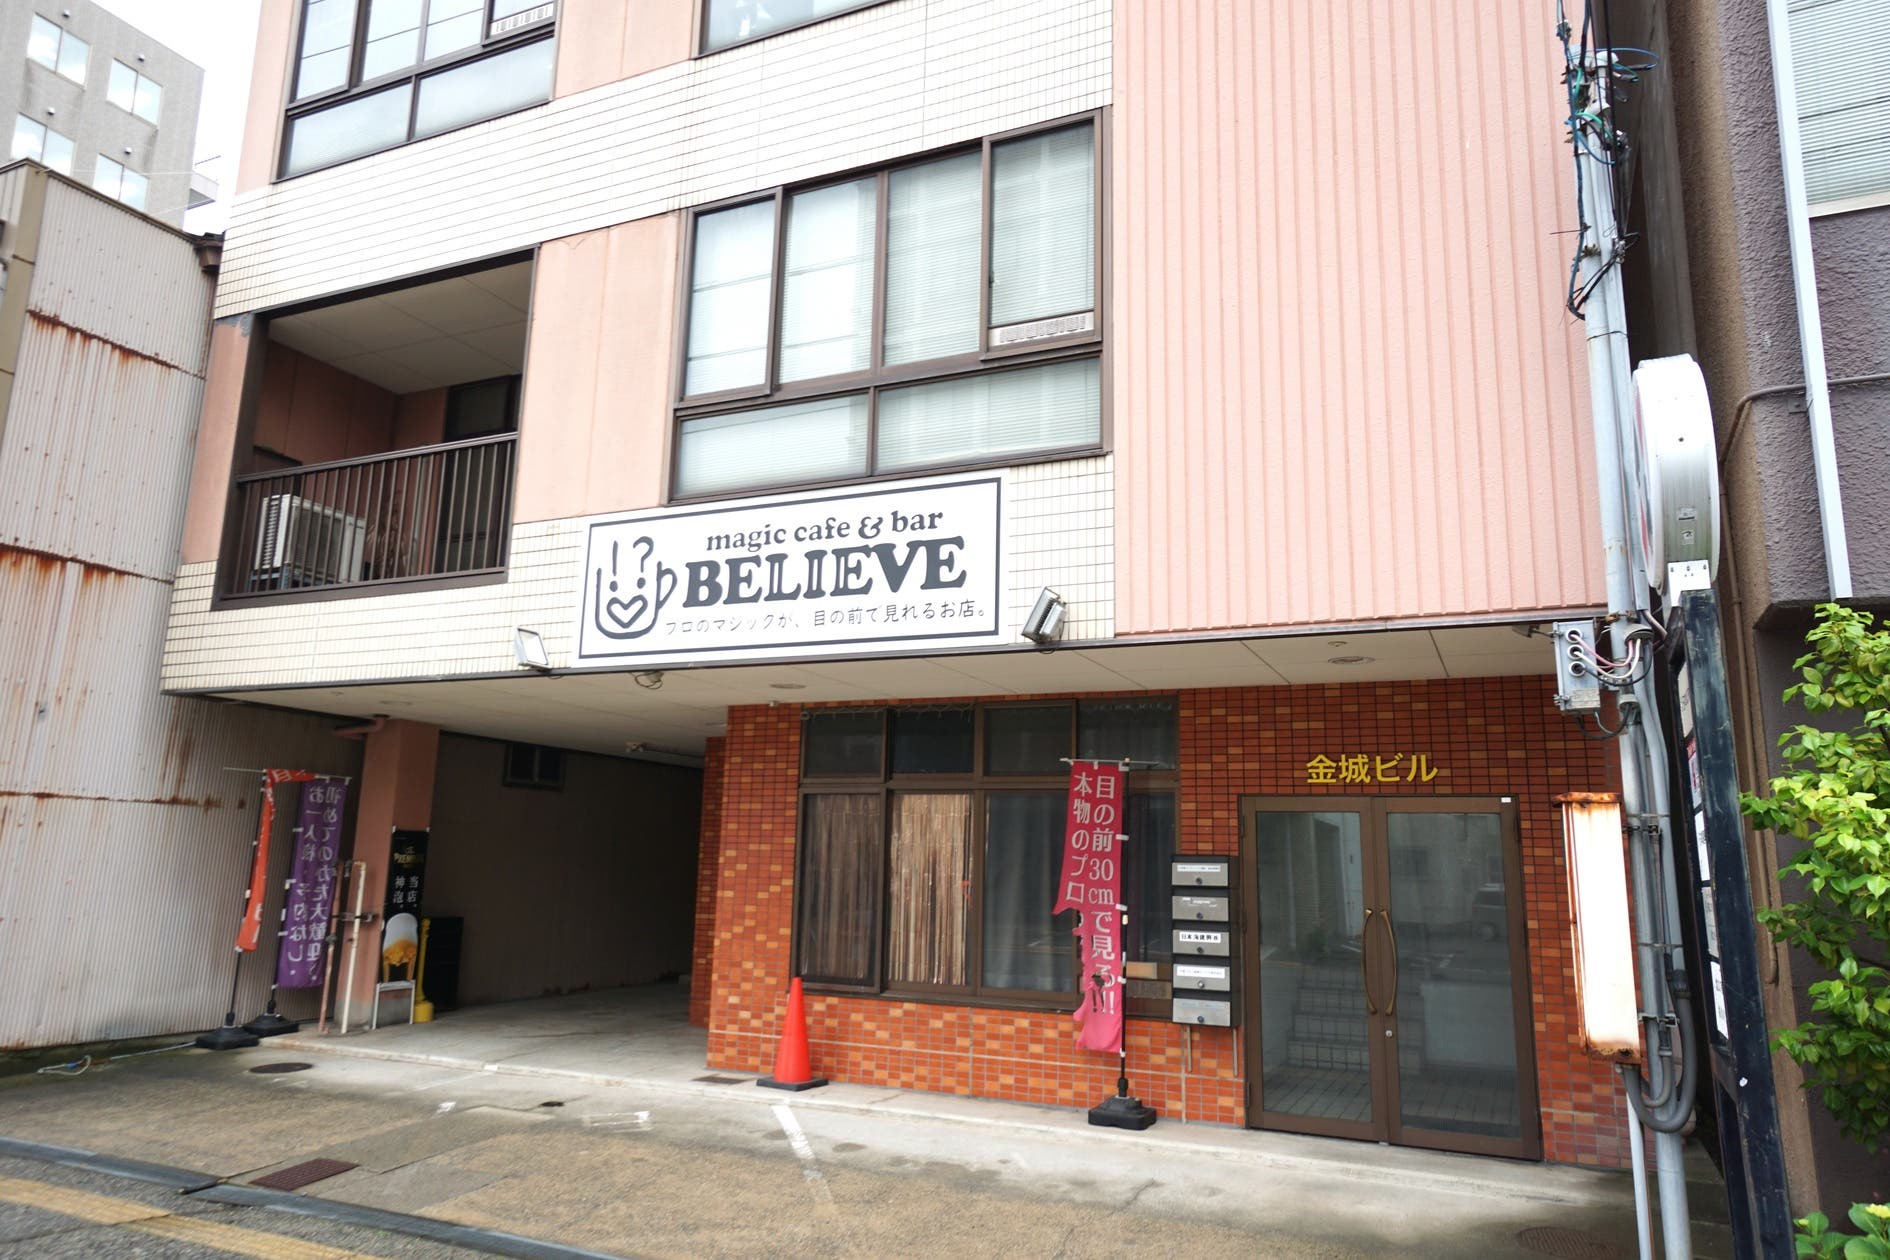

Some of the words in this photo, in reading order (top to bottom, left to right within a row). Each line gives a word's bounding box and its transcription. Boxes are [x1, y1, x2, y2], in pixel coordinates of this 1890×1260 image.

[706, 523, 787, 553] magic
[793, 517, 851, 542] cafe
[858, 516, 884, 540] &
[890, 510, 944, 533] bar
[682, 535, 968, 608] BELIEVE
[1306, 753, 1439, 784] 金城ビル
[1066, 771, 1093, 945] 本物のプロ
